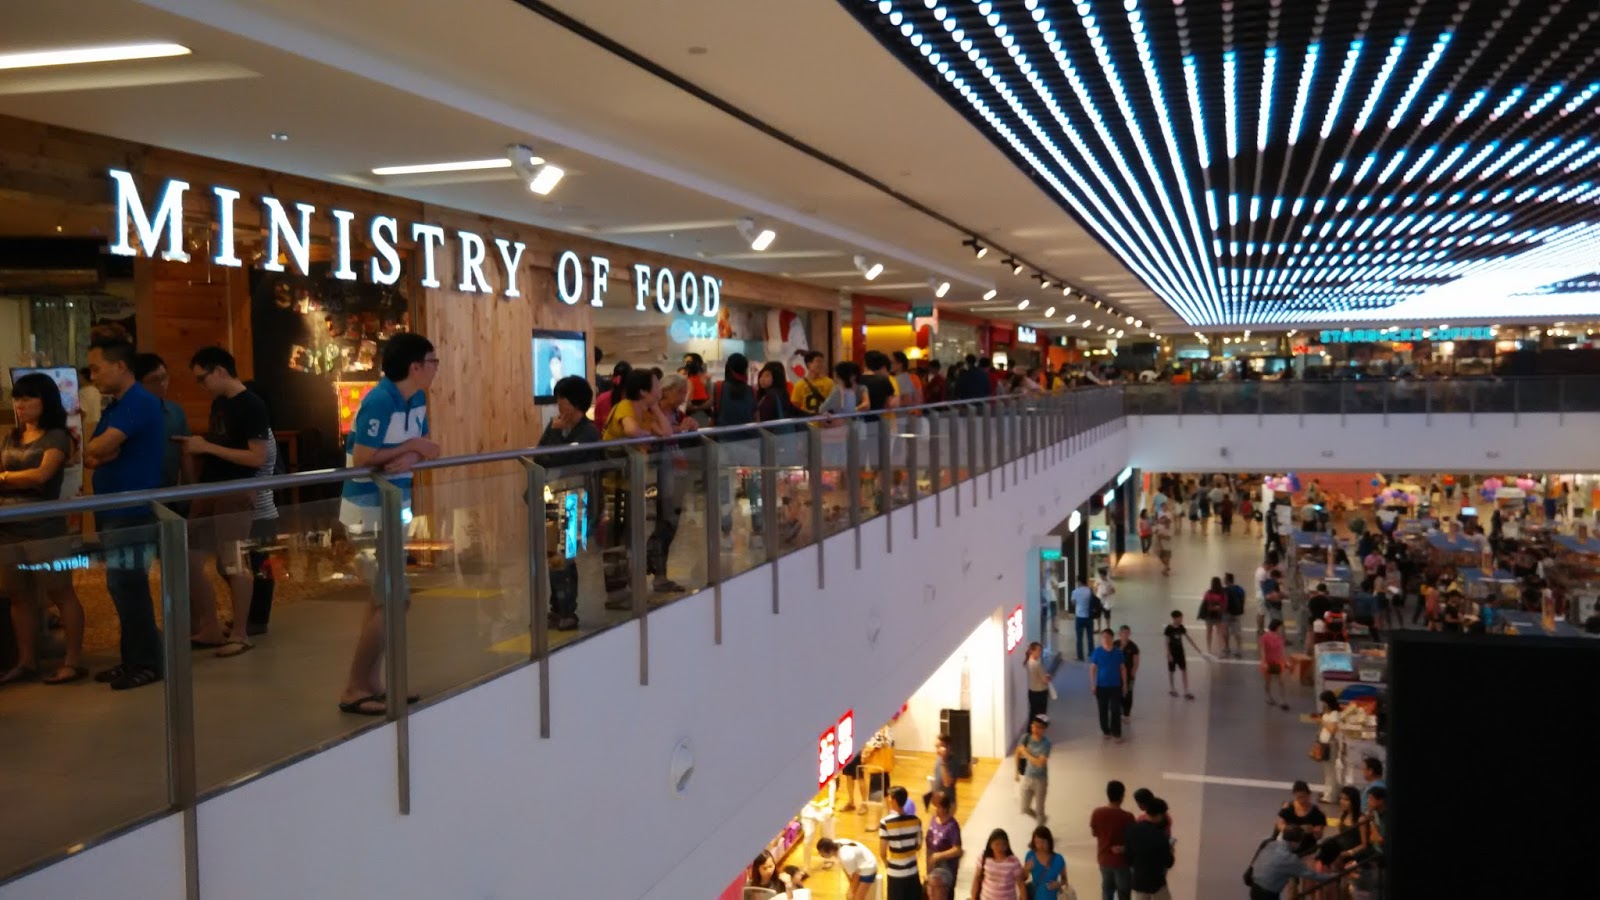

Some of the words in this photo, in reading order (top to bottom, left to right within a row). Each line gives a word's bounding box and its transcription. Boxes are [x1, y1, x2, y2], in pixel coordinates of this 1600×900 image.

[109, 169, 526, 298] MINISTRY
[557, 250, 610, 308] OF
[633, 264, 720, 318] FOOD
[1319, 327, 1424, 344] STARBUCKS
[368, 418, 380, 437] 3
